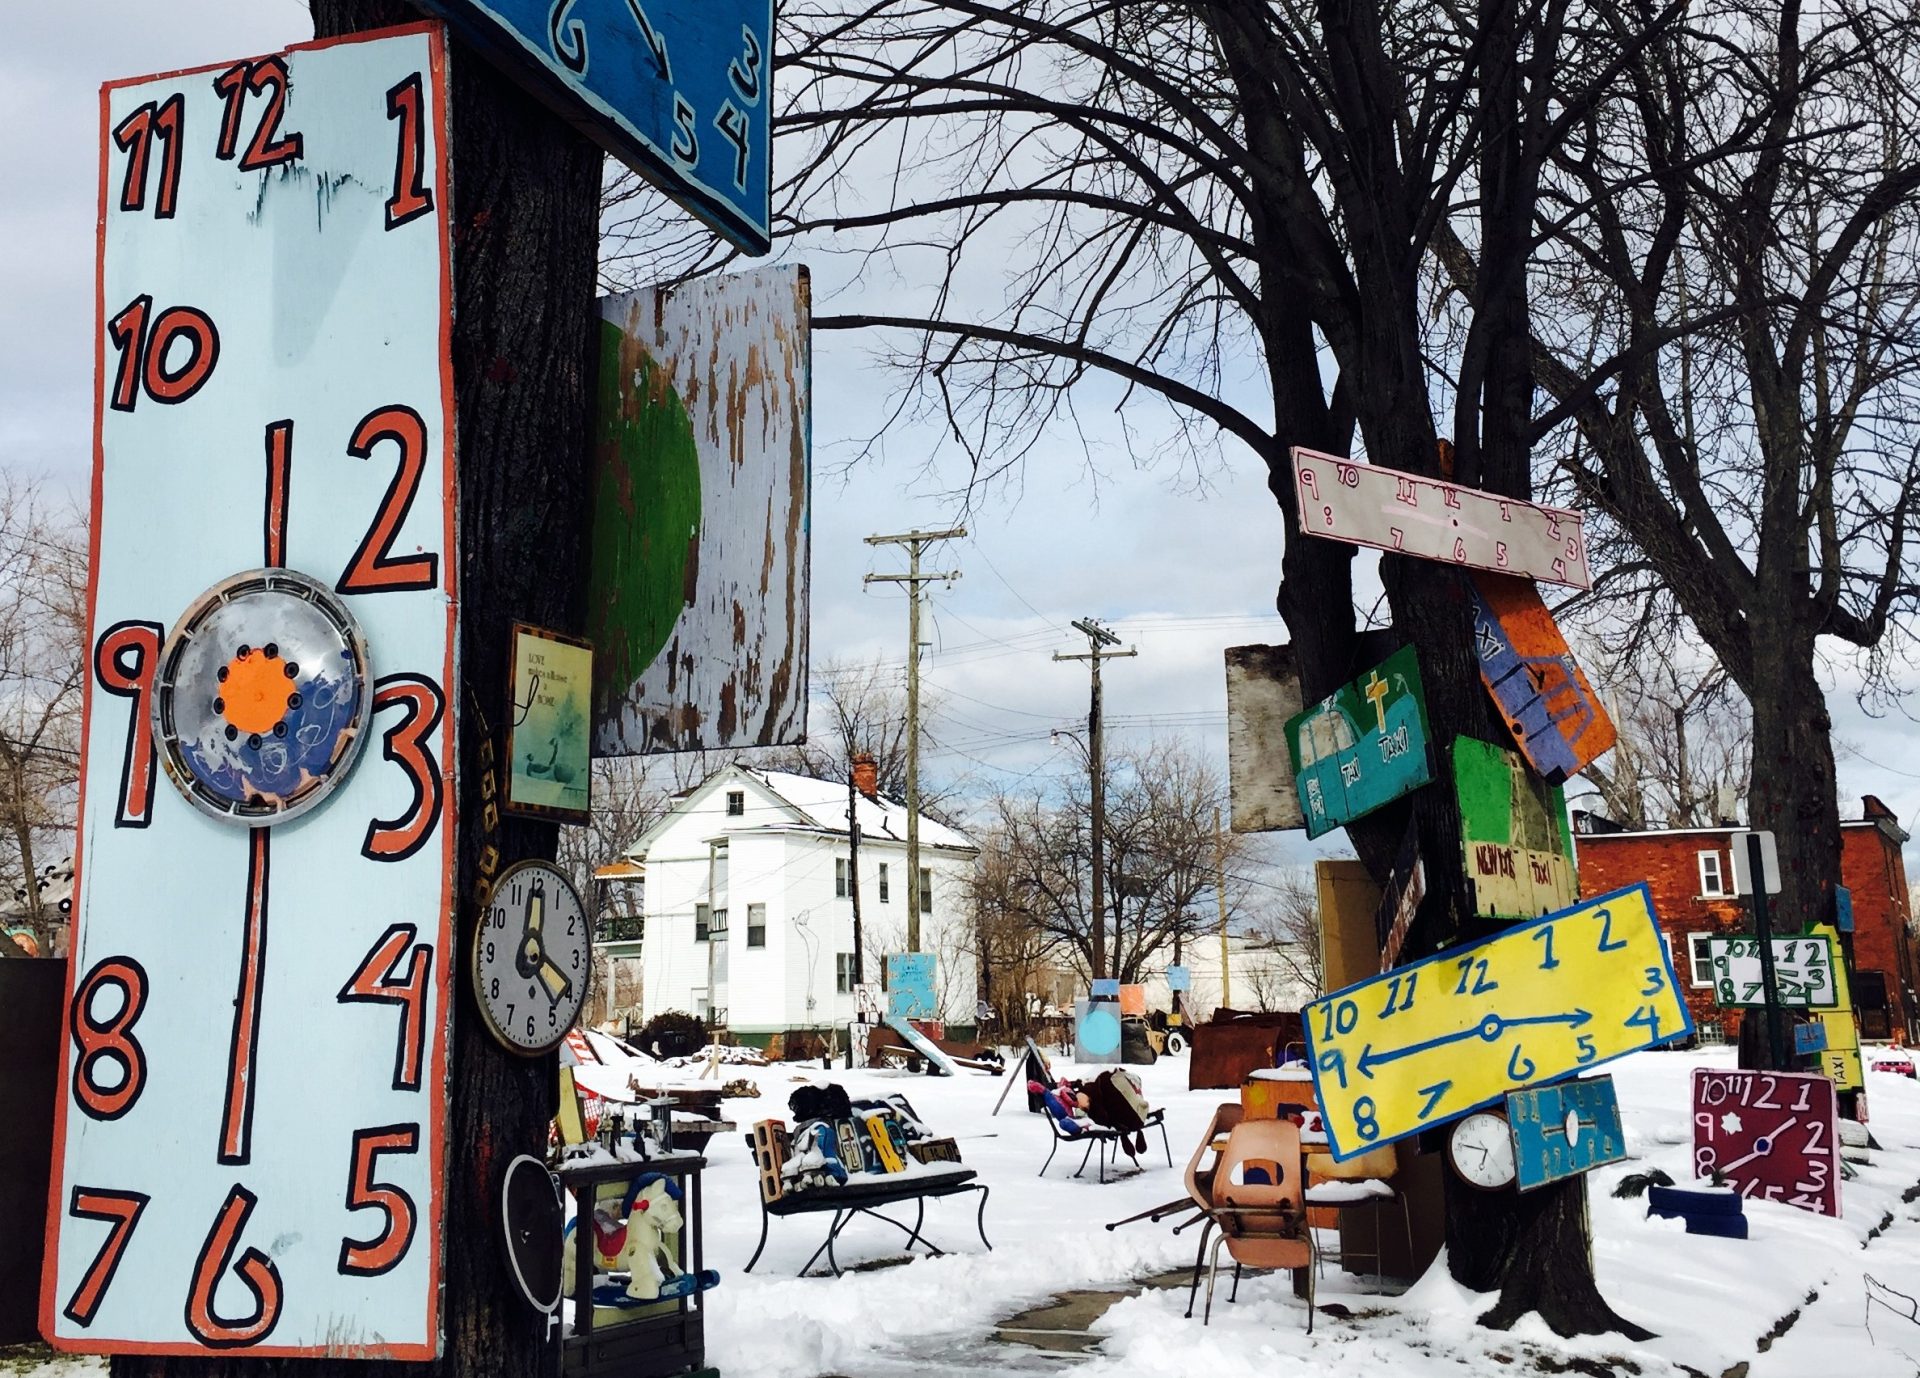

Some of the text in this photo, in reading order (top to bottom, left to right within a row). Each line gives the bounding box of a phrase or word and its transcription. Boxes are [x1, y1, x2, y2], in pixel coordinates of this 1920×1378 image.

[729, 24, 761, 107] 3
[113, 55, 434, 231] 11 12 1
[671, 90, 699, 171] 5
[713, 98, 750, 195] 4
[108, 294, 220, 412] 10
[335, 405, 437, 594] 2
[1299, 463, 1578, 560] 9 10 11 12 1 2 3
[1323, 506, 1567, 581] 8 7 6 5 4
[94, 620, 446, 861] 9 3
[1476, 844, 1498, 875] NEW
[493, 908, 575, 936] 10 2
[512, 877, 560, 910] 11 12 1
[486, 943, 580, 969] 9 3
[1319, 909, 1628, 1042] 10 11 12 1 2
[1641, 967, 1665, 996] 3
[1714, 956, 1825, 990] 9 3
[1725, 940, 1745, 958] 10
[1783, 941, 1798, 963] 1
[1804, 942, 1826, 967] 2
[491, 978, 573, 1003] 8 4
[506, 1004, 557, 1027] 7 5
[1719, 977, 1736, 1004] 8
[1742, 982, 1764, 1001] 7
[71, 924, 433, 1121] 8 4
[526, 1016, 535, 1037] 6
[1318, 1005, 1661, 1089] 9 4
[1353, 1034, 1598, 1140] 8 7 6 5
[1701, 1075, 1811, 1111] 10 11 12 1
[1832, 1057, 1848, 1085] TAXI
[1695, 1112, 1829, 1154] 9 2
[338, 1123, 419, 1276] 5
[1696, 1147, 1716, 1179] 8
[1795, 1160, 1828, 1192] 3
[64, 1183, 283, 1348] 7 6
